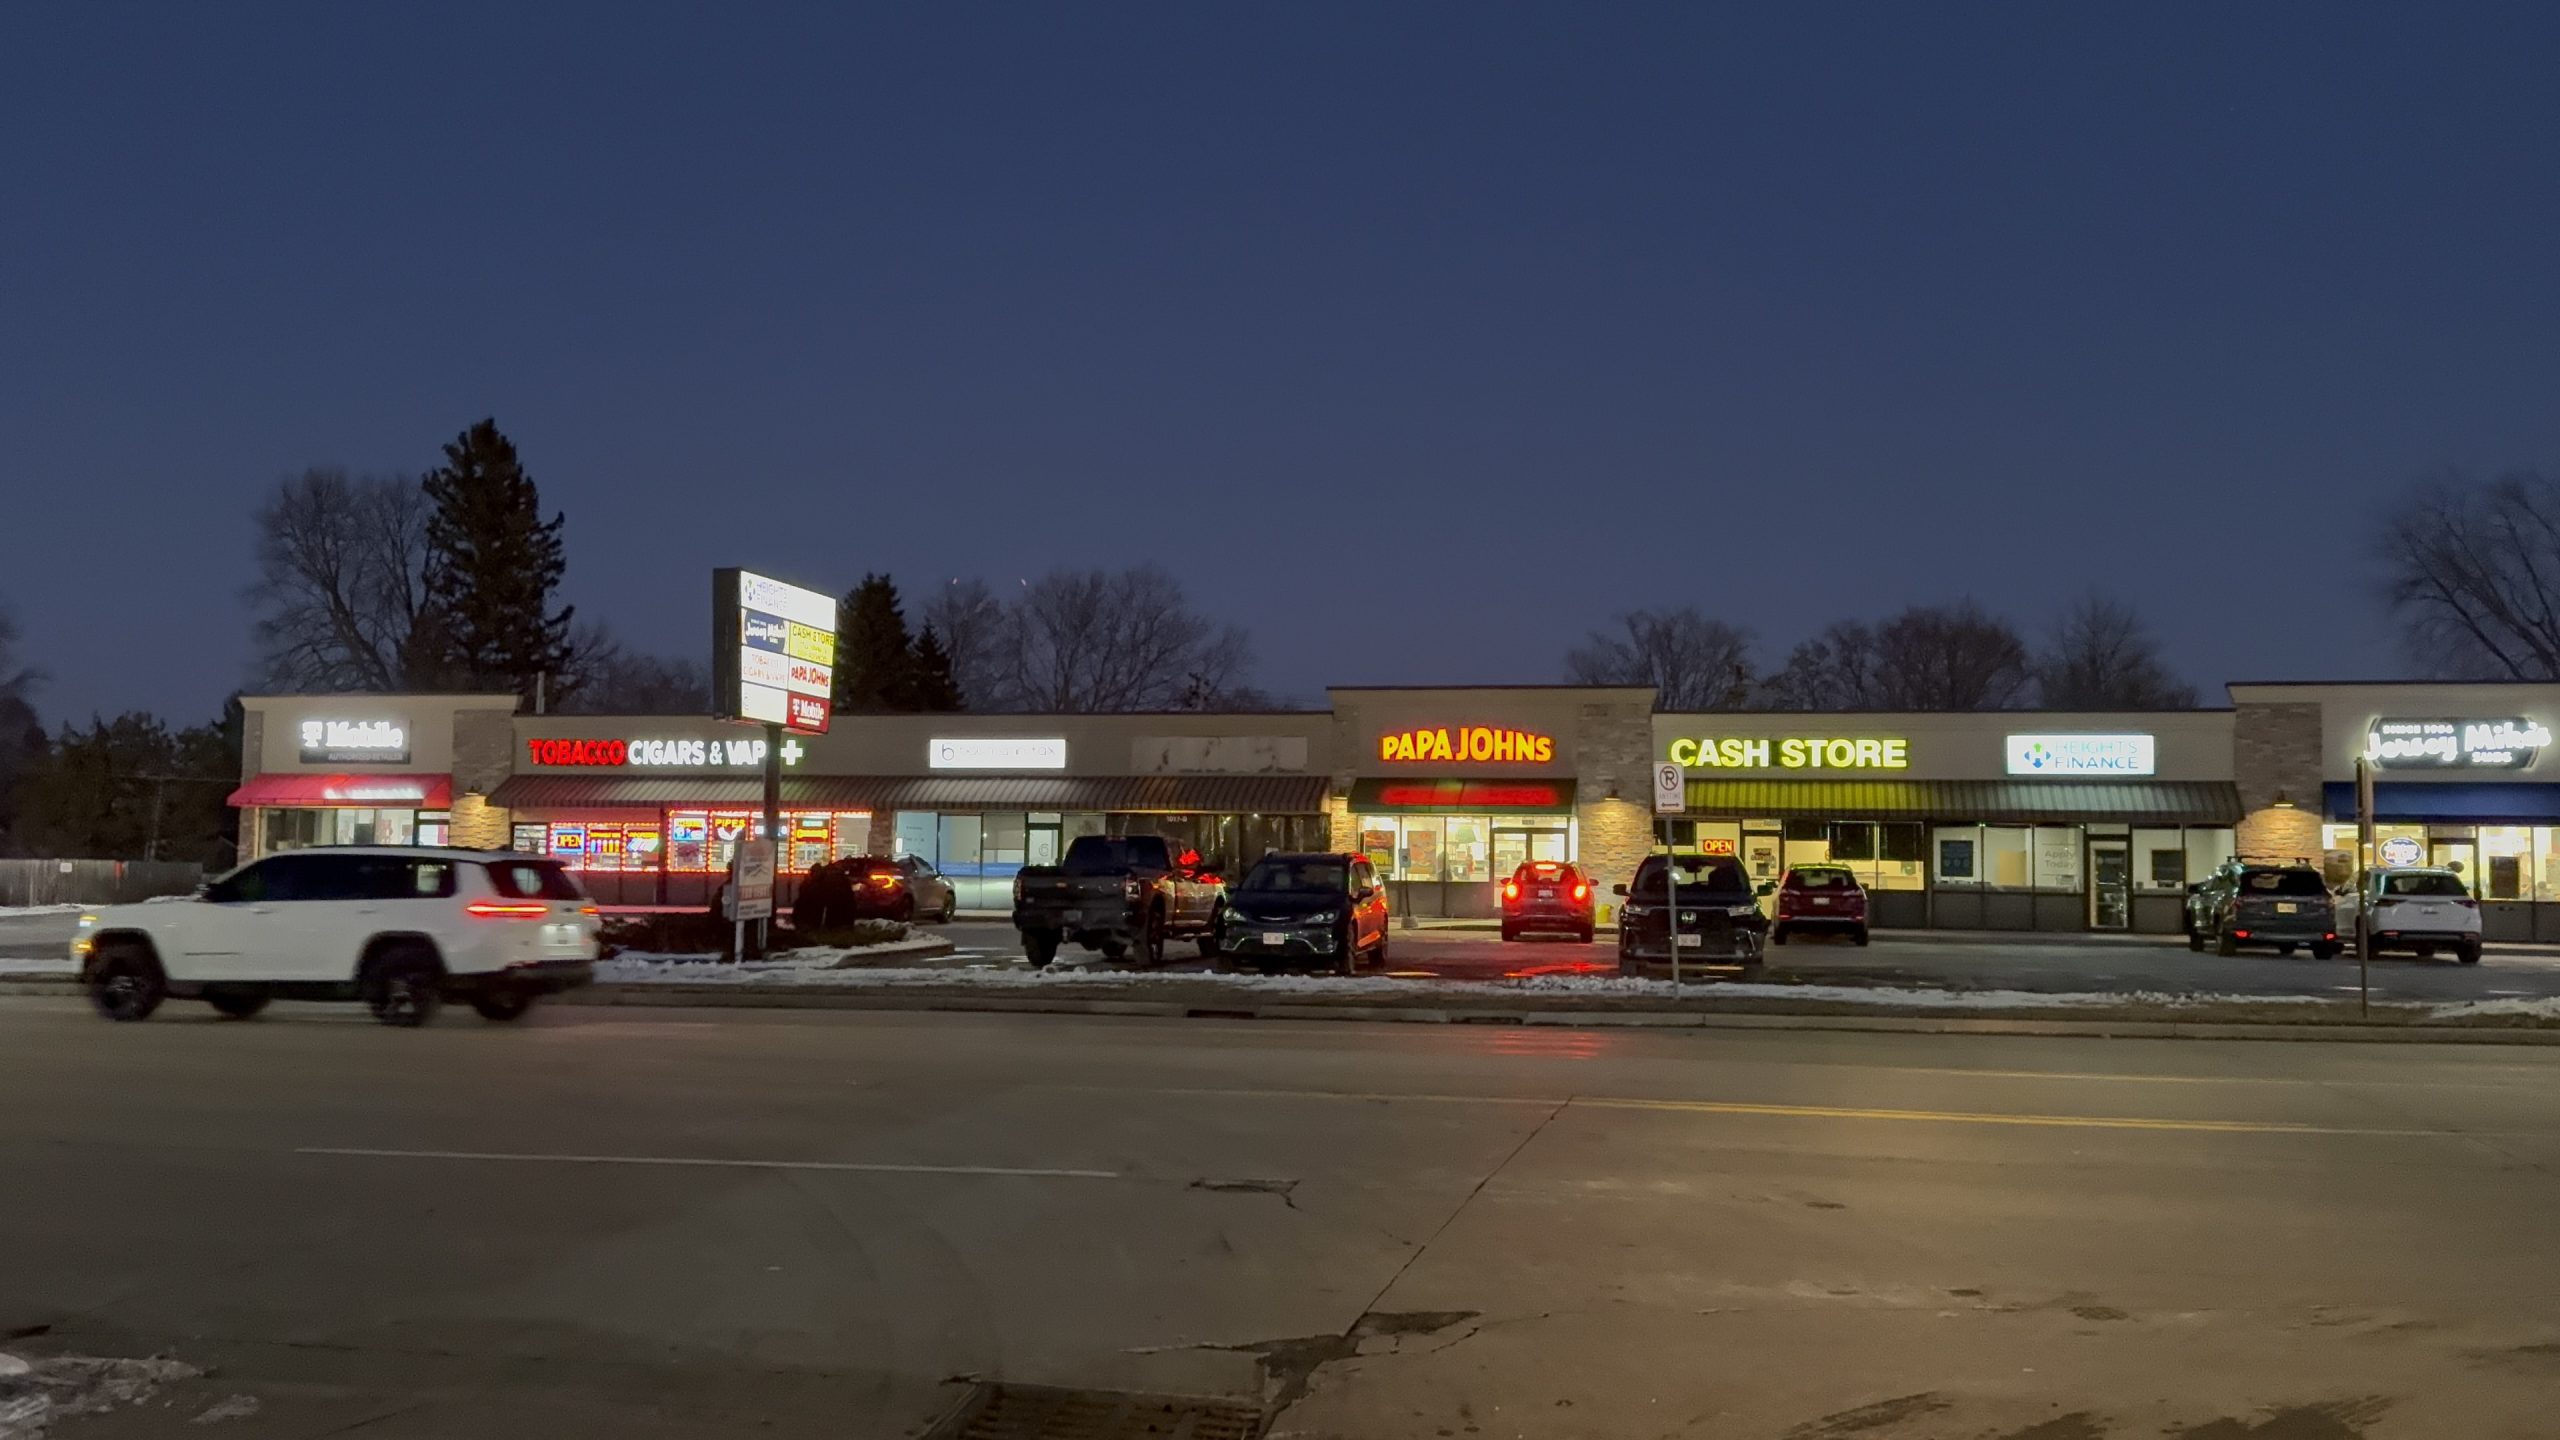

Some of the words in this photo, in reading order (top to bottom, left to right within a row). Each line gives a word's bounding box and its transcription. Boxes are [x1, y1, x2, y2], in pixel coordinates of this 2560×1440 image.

[792, 625, 812, 640] CASH
[791, 665, 807, 682] PAPA
[807, 667, 829, 688] JOHNS
[801, 700, 825, 720] Mobile
[325, 721, 403, 748] Mobile
[1382, 728, 1453, 761] PAPA
[1455, 727, 1552, 762] JOHNS
[2055, 741, 2139, 754] HEIGHTS
[2363, 732, 2458, 762] Jersey
[529, 739, 626, 767] TOBACCO
[628, 740, 706, 766] CIGARS
[709, 741, 723, 766] &
[726, 740, 767, 766] VAP
[1670, 738, 1769, 767] CASH
[1780, 738, 1907, 768] STORE
[2055, 756, 2139, 769] FINANCE
[714, 818, 746, 828] PIPES
[557, 834, 581, 848] OPEN
[1704, 840, 1733, 852] OPEN
[2045, 850, 2076, 859] Apply
[2045, 860, 2075, 869] Today
